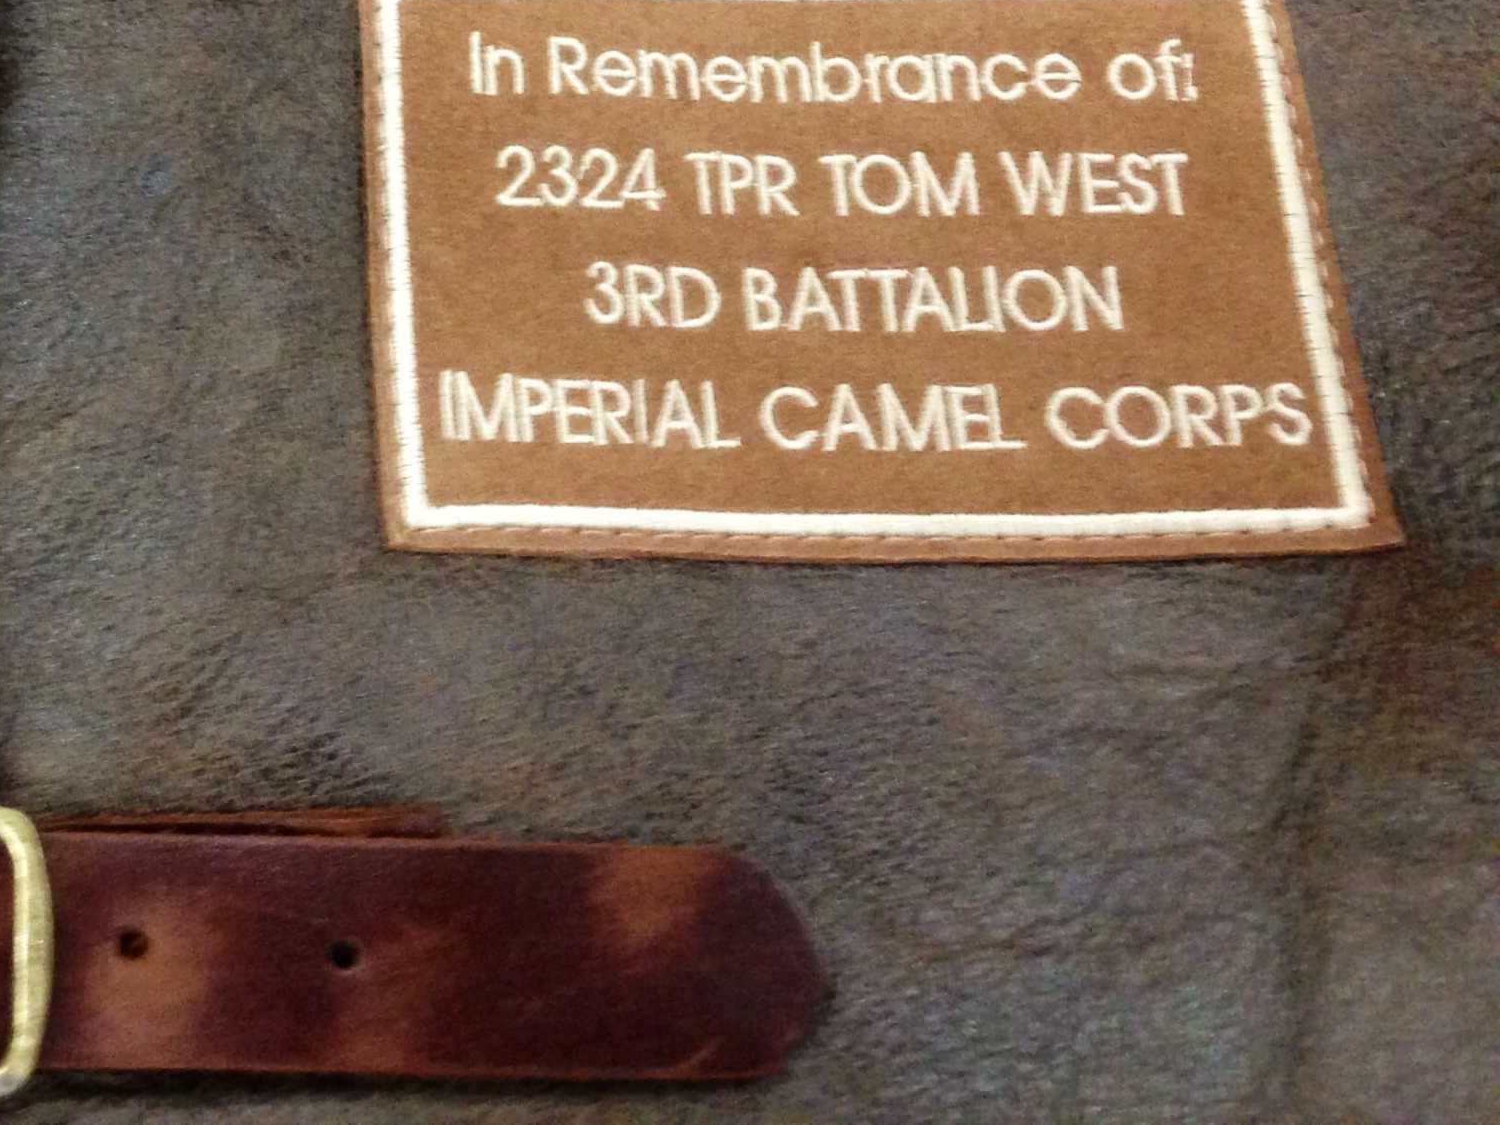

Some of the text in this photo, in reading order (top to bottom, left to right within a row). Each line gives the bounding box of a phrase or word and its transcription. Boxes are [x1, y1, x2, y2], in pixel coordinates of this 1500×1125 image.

[469, 31, 525, 95] In
[549, 36, 1080, 103] Remembrance
[496, 142, 1187, 216] 2324 TPR TOM WEST
[584, 260, 1123, 331] 3RD BATTALION
[438, 370, 1313, 450] IMPERIAL CAMEL CORPS
